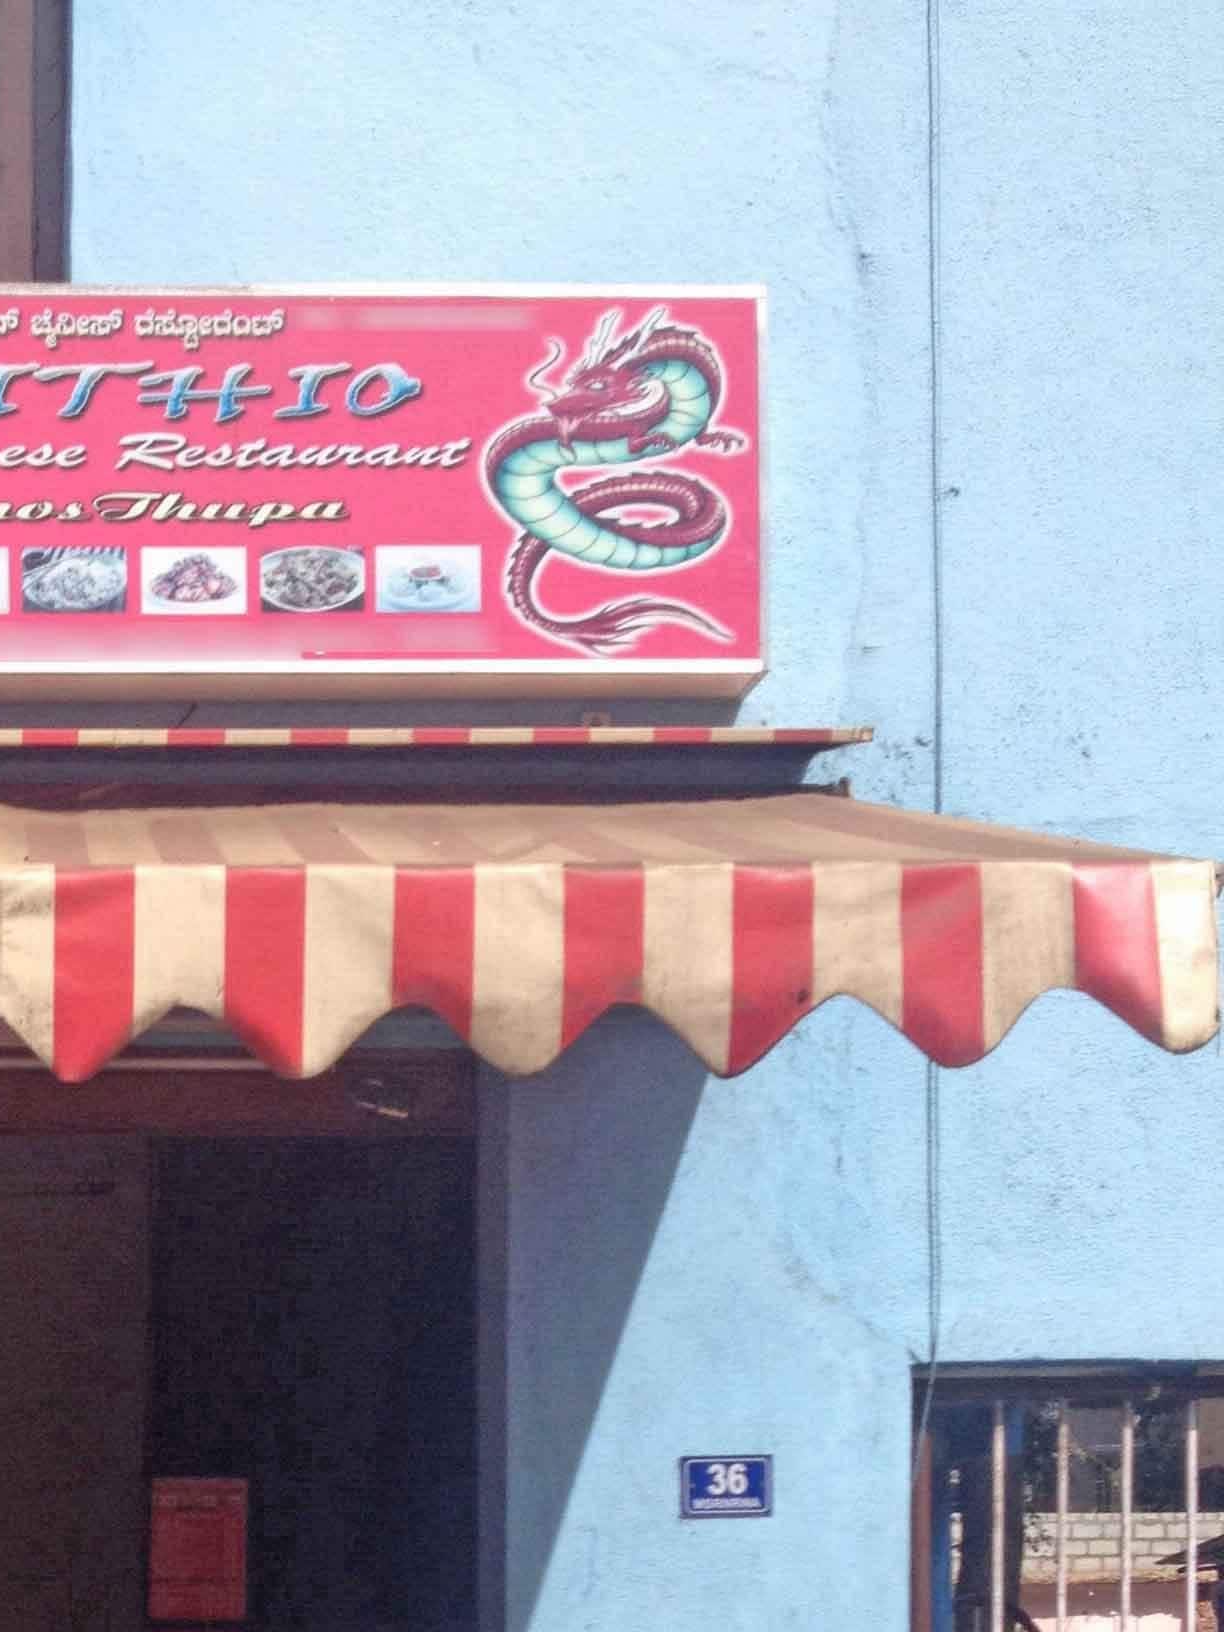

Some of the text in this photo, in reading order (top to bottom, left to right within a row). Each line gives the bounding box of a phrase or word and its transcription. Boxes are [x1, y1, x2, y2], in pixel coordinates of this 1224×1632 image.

[115, 432, 474, 469] Restaurant
[93, 492, 351, 528] Thupa
[706, 1463, 748, 1495] 36
